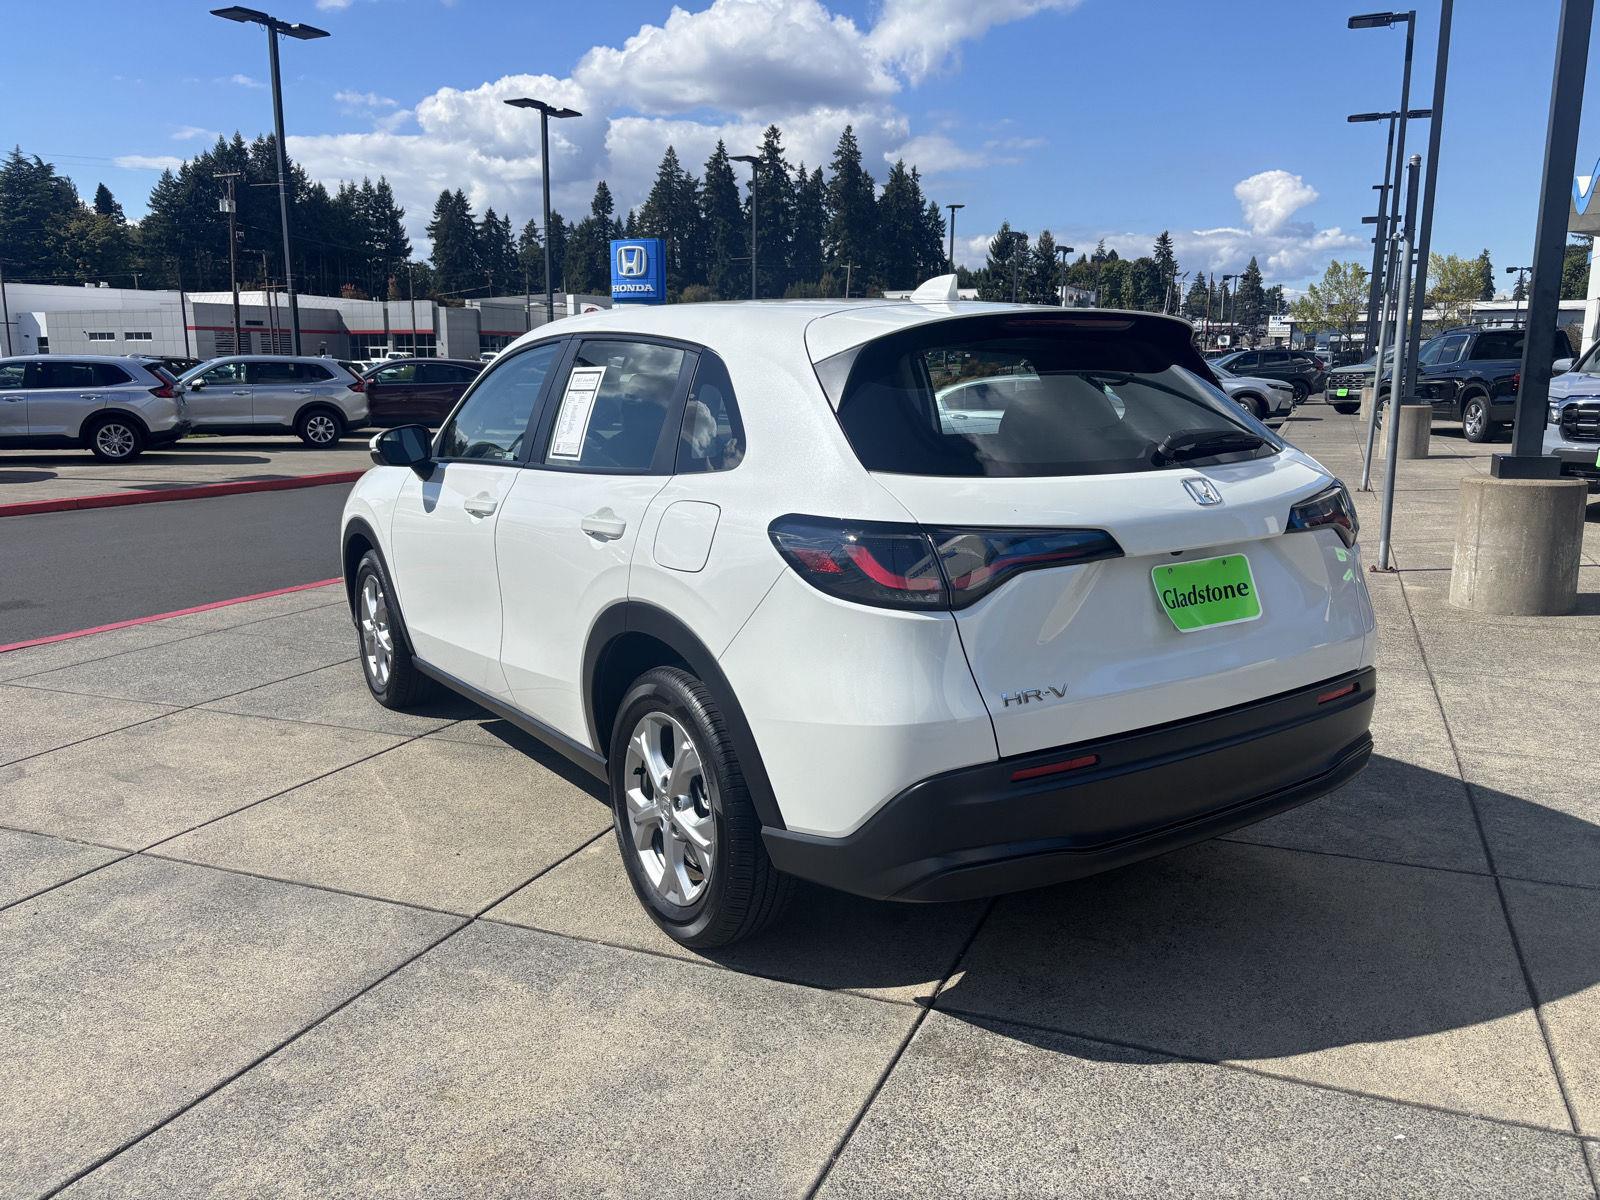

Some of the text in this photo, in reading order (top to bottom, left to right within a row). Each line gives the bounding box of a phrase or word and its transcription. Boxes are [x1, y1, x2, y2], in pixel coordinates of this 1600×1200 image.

[612, 284, 655, 292] HONDA
[1163, 582, 1250, 610] Gladstone
[1000, 682, 1069, 707] HR-V
